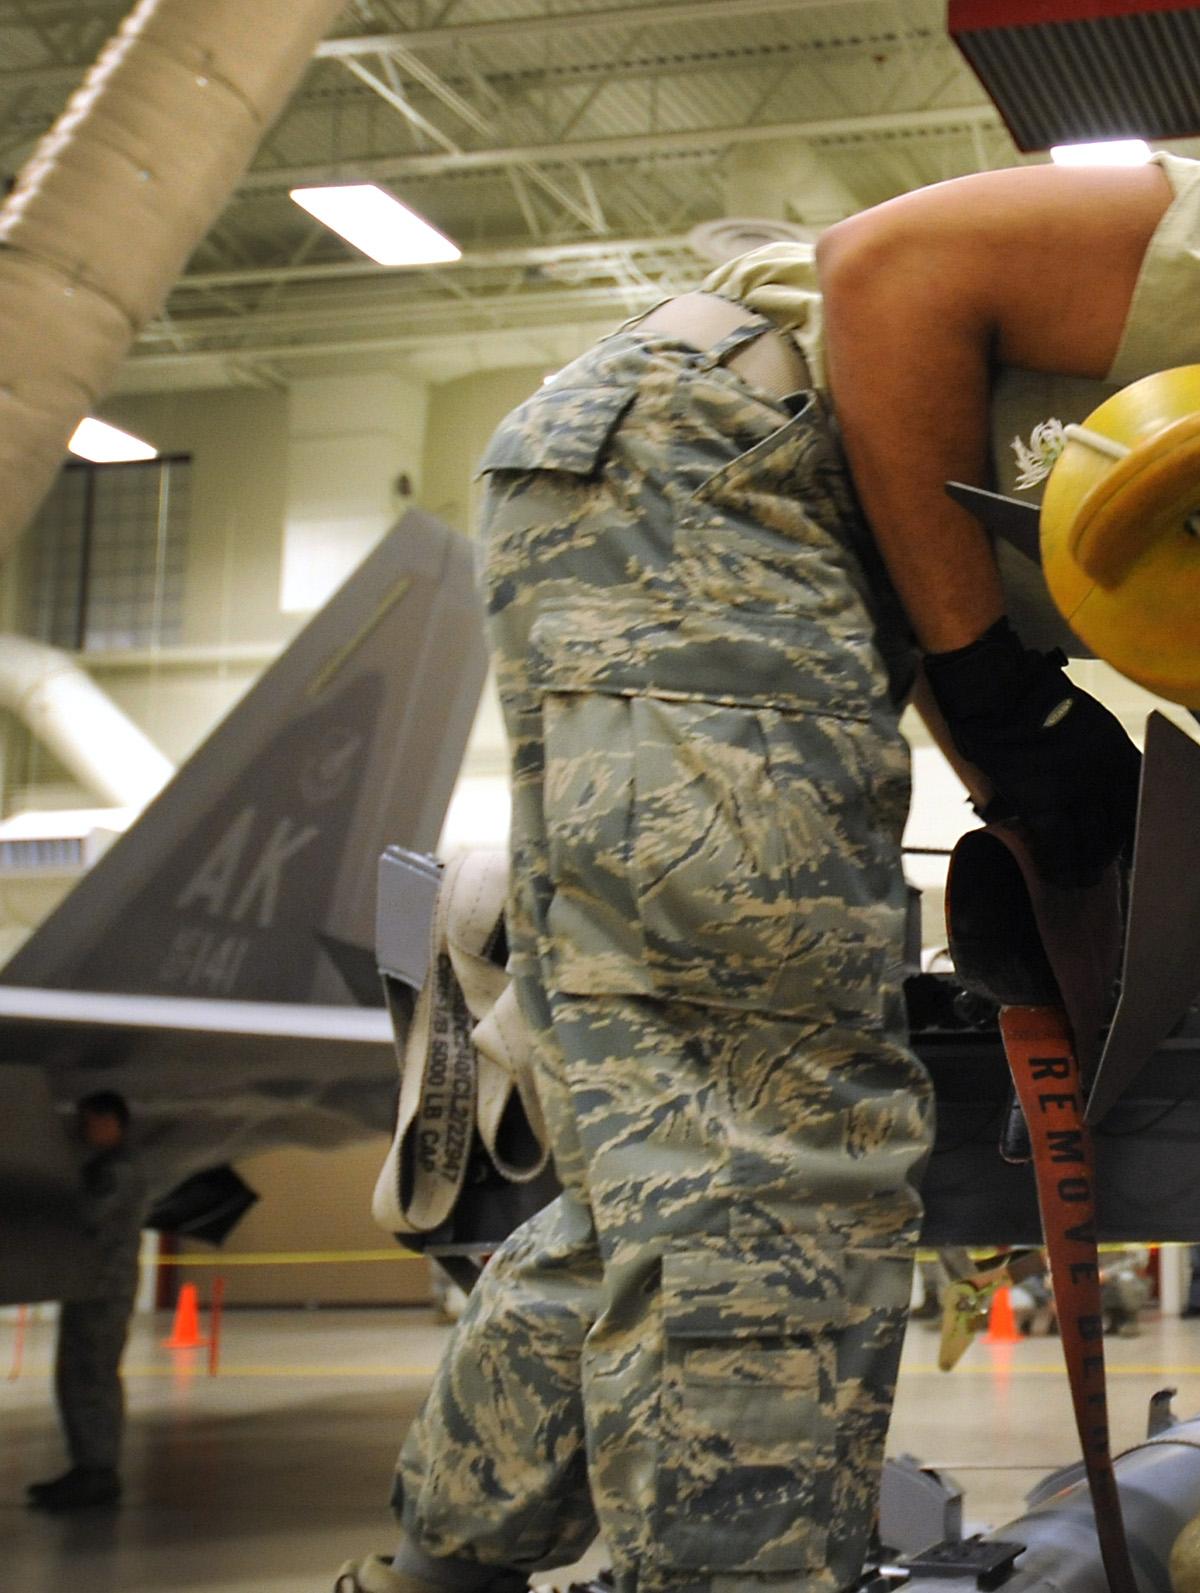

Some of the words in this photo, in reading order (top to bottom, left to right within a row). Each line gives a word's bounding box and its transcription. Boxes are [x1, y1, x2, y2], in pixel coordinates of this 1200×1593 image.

[176, 805, 320, 929] AK
[423, 1095, 443, 1121] LB
[419, 1130, 440, 1174] CAP
[1029, 1056, 1097, 1285] REMOVE
